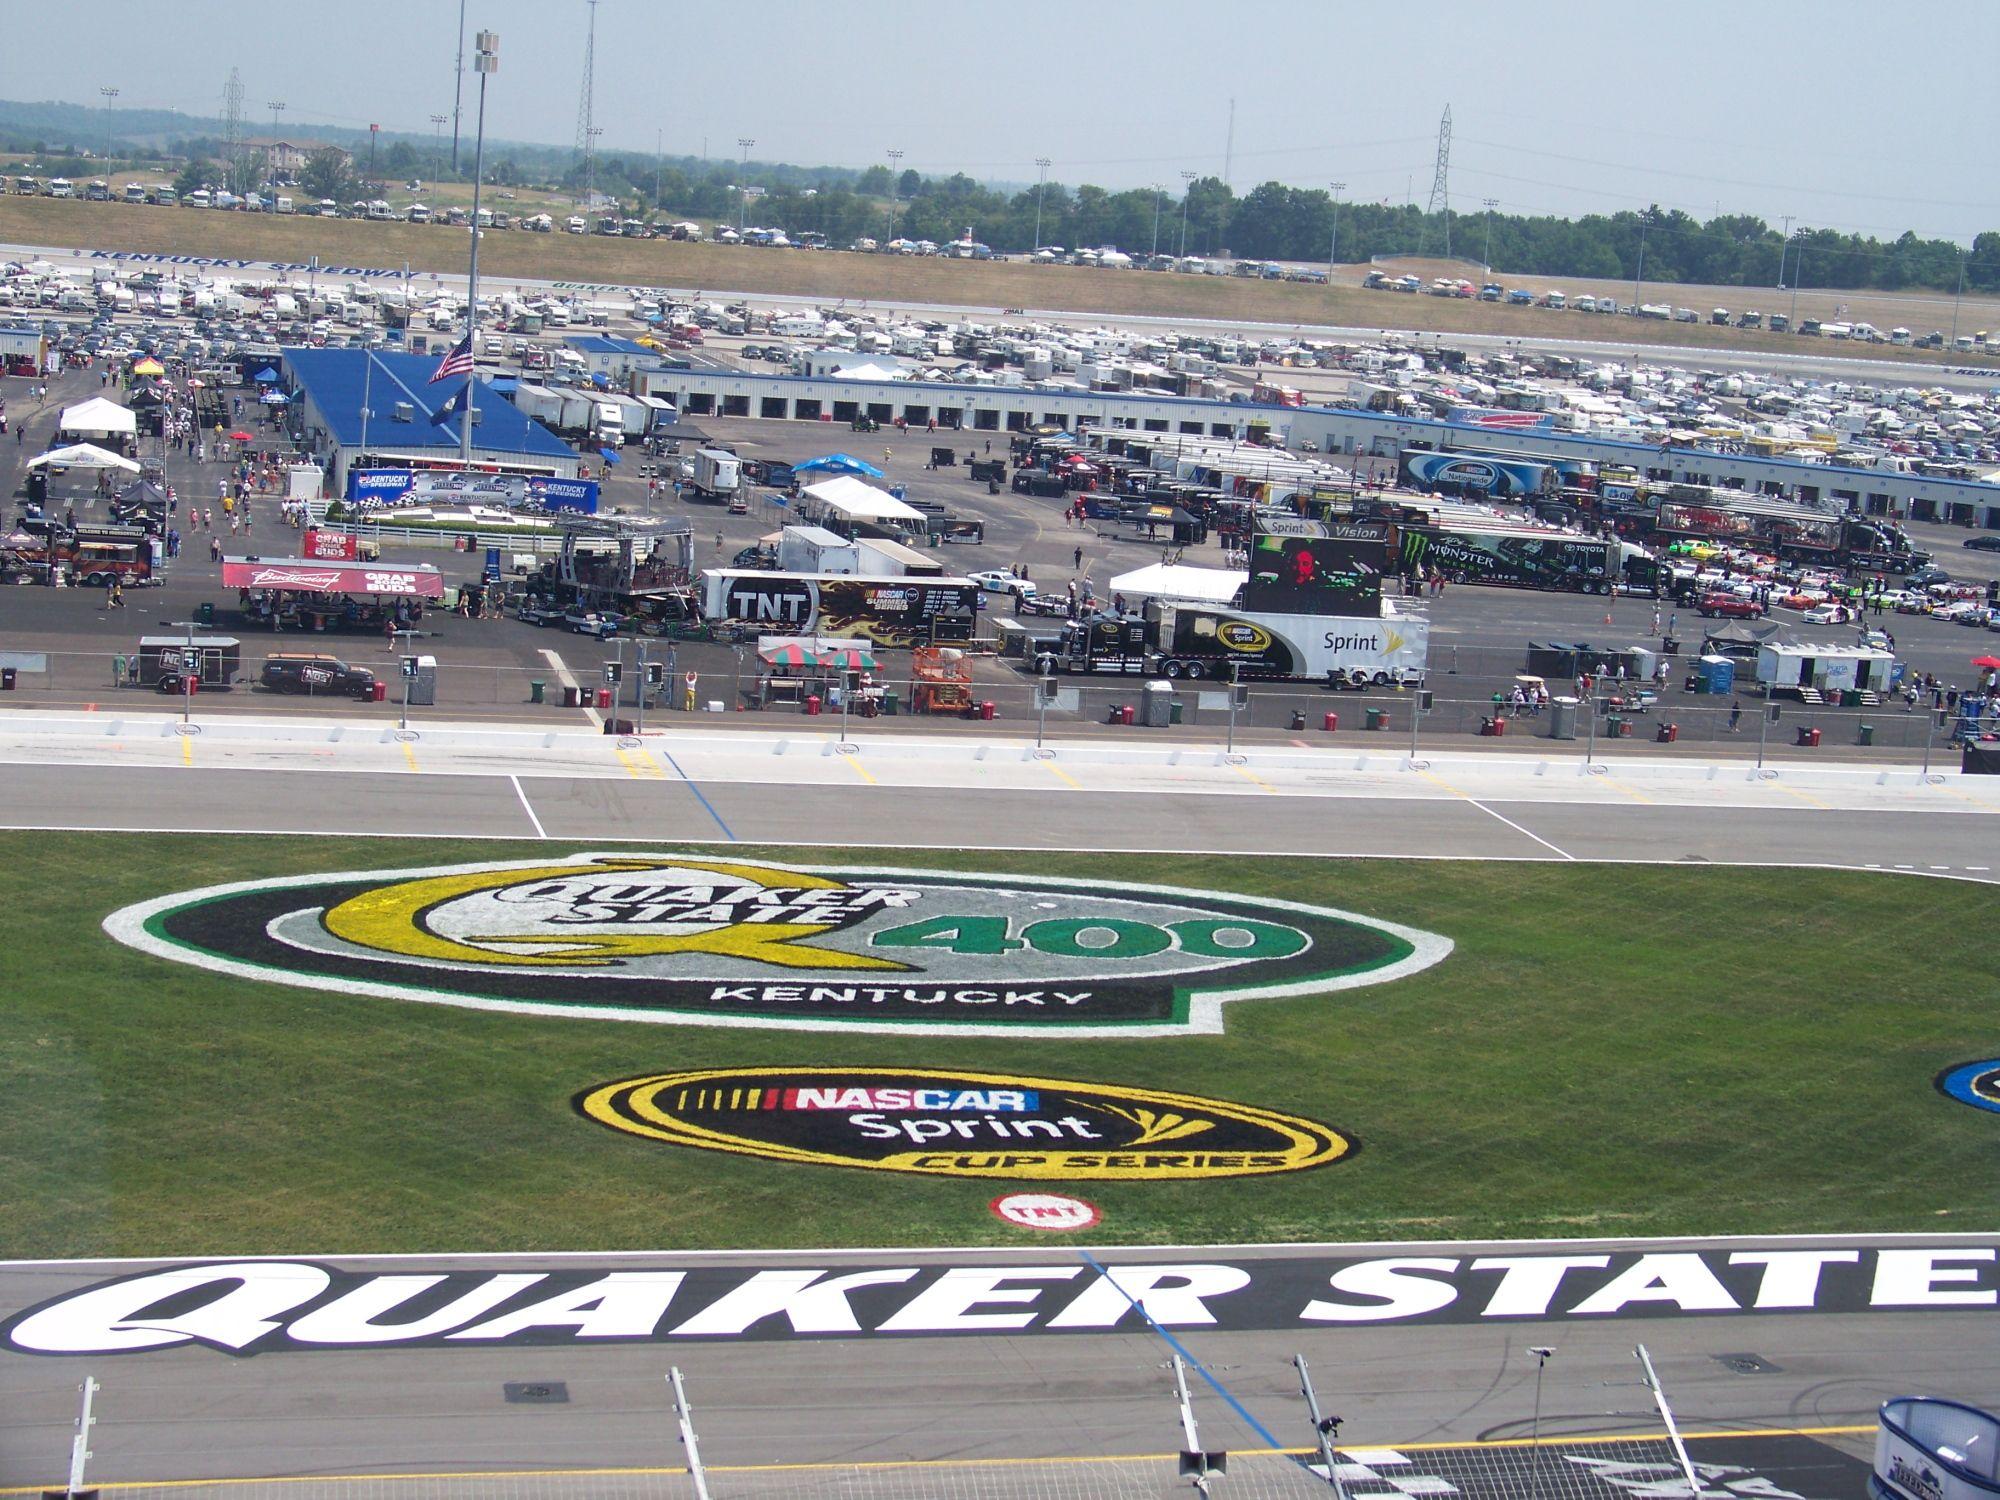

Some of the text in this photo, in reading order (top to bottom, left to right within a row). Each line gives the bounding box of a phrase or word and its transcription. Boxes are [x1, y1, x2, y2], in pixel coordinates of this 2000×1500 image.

[90, 250, 256, 268] KENTUCKY
[552, 282, 619, 292] QUAKER
[1955, 368, 2000, 377] KENT
[371, 475, 409, 484] KENTUCKY
[1448, 473, 1489, 485] Nationwide
[547, 483, 587, 495] KENTUCKY
[1272, 522, 1304, 534] Sprint
[1336, 526, 1378, 539] Vision
[316, 534, 346, 544] GRAB
[315, 547, 346, 557] BUDS
[1428, 543, 1494, 568] MONSTER
[1576, 545, 1605, 553] TOYOTA
[252, 570, 340, 585] Budweiser
[365, 572, 416, 582] GRAB
[367, 584, 416, 593] BUDS
[876, 589, 904, 599] NASCAR
[733, 591, 807, 621] TNT
[1234, 635, 1253, 643] Sprint
[1324, 632, 1379, 654] Sprint
[305, 668, 330, 684] NOS
[493, 880, 924, 908] QUAKER
[550, 903, 864, 925] STATE
[868, 914, 1314, 960] 400
[709, 985, 1094, 1007] KENTUCKY
[795, 1087, 1027, 1112] NASCAR
[848, 1112, 1106, 1144] Sprint
[913, 1153, 1292, 1170] CUP SERIES
[1009, 1204, 1083, 1220] TNT
[9, 1247, 1997, 1351] QUAKER STATE
